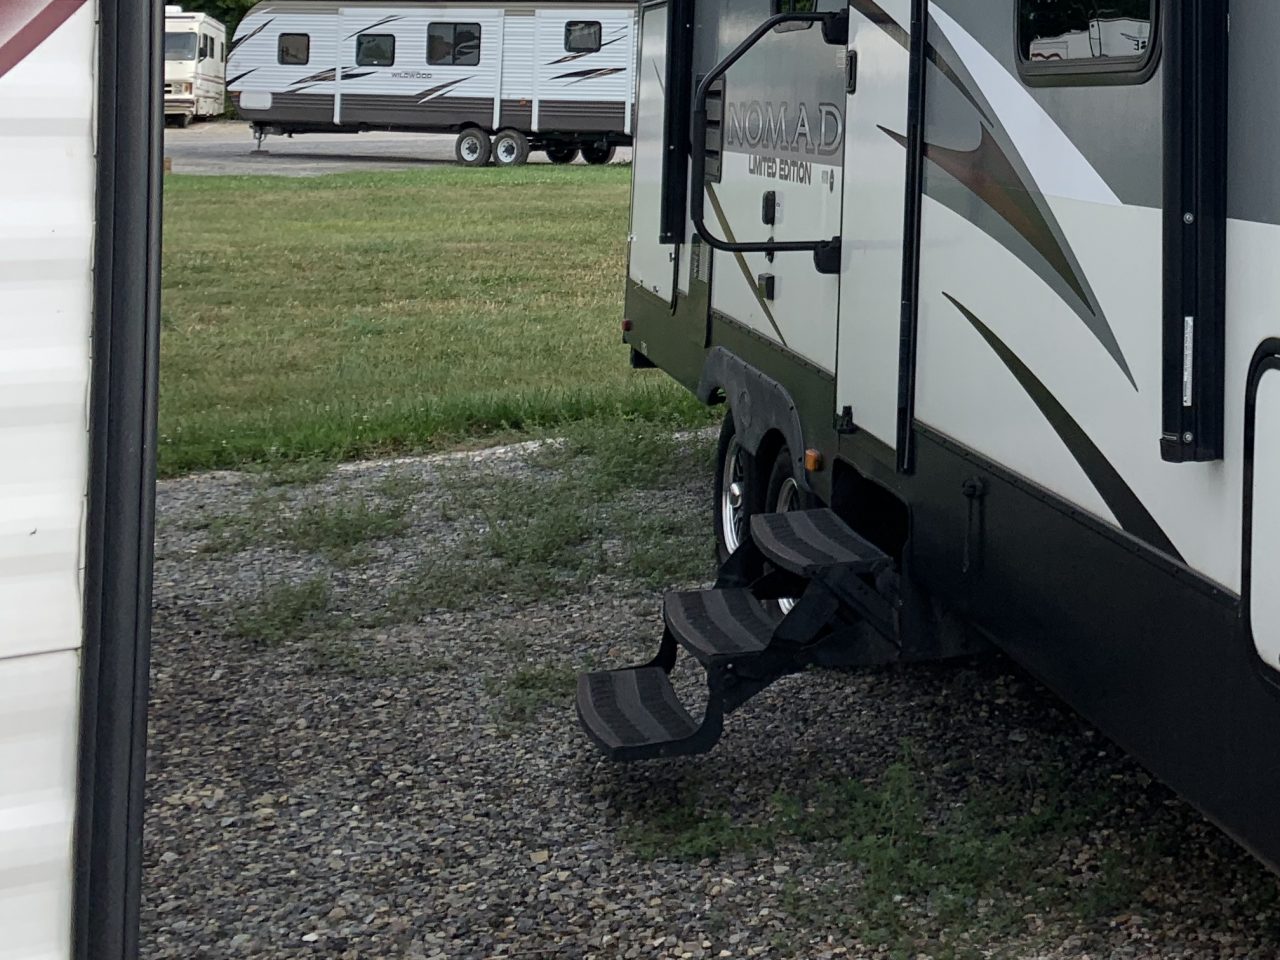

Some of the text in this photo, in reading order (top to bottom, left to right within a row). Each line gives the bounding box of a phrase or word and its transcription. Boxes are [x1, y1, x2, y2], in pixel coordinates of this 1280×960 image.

[727, 100, 843, 156] NOMAD
[748, 154, 812, 186] LIMITED EDITION
